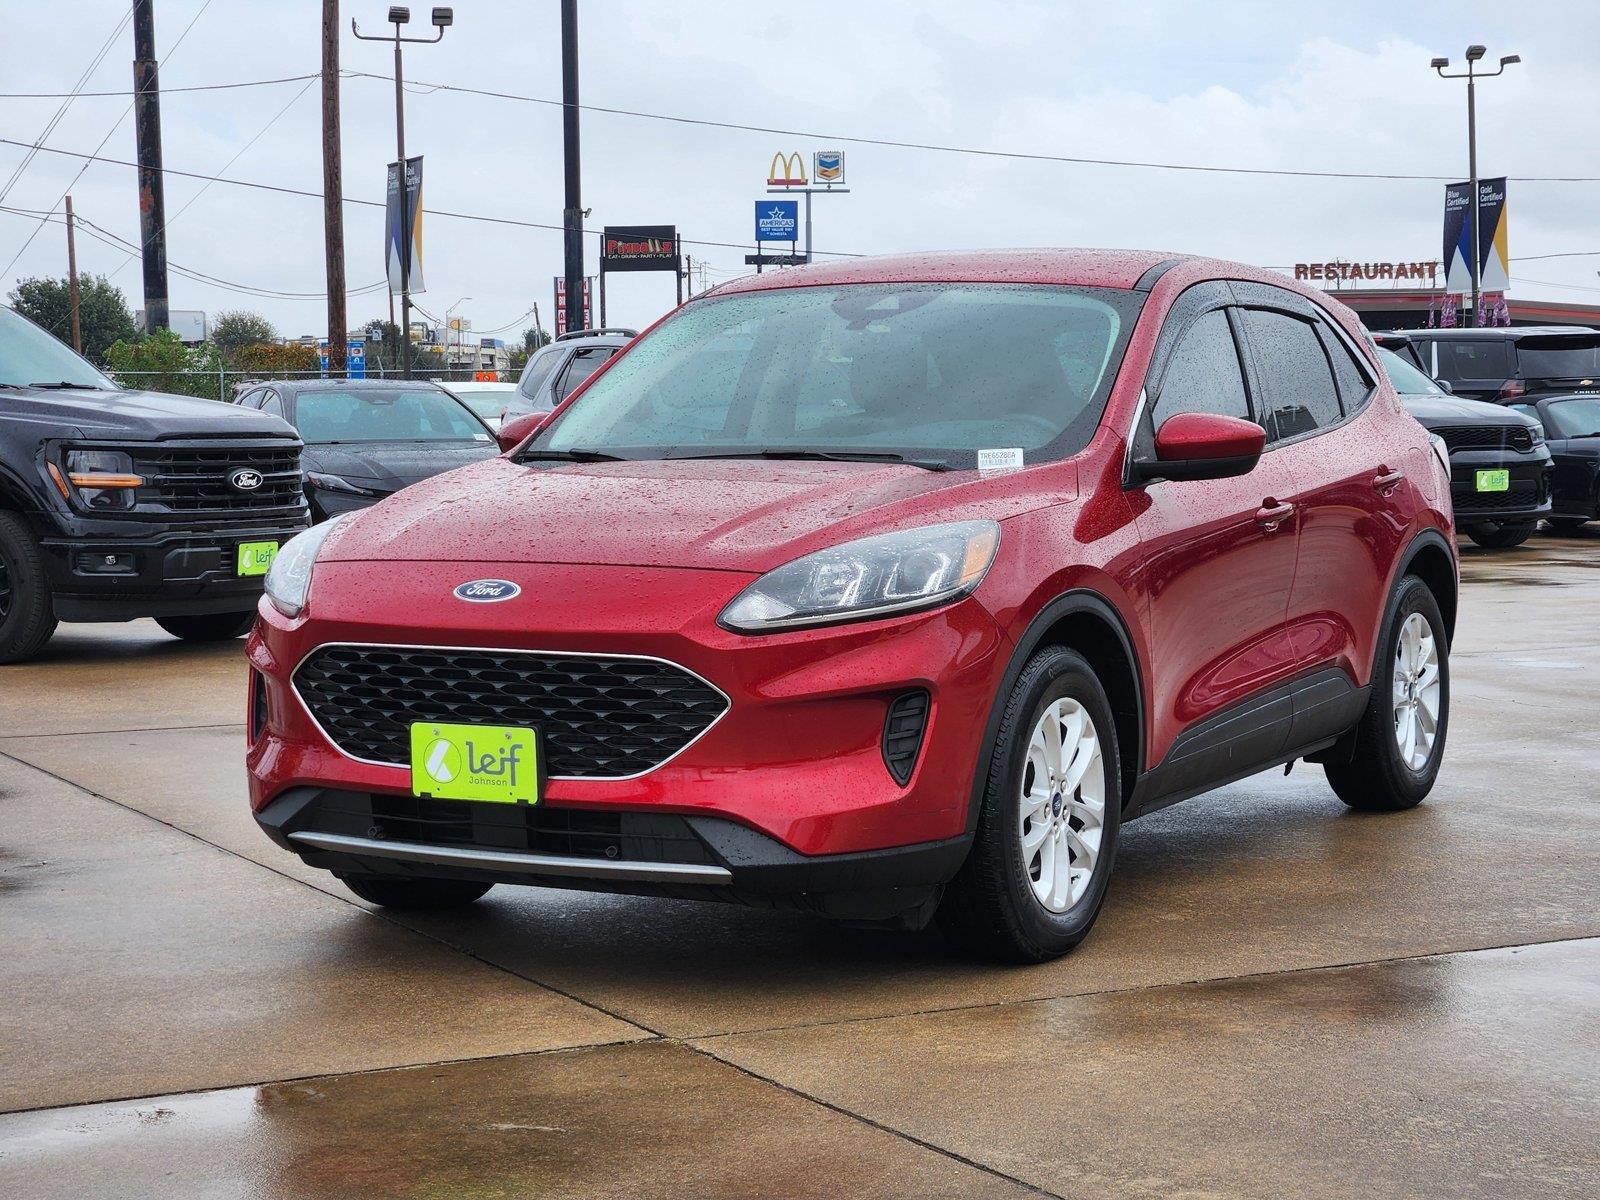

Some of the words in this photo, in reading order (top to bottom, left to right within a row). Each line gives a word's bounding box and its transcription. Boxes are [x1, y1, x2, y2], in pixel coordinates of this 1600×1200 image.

[1447, 190, 1460, 199] Blue
[1480, 185, 1493, 194] Gold
[1446, 197, 1470, 206] Certified
[1480, 192, 1504, 202] Certified
[761, 219, 794, 227] AMERICAS
[1294, 261, 1438, 280] RESTAURANT
[238, 473, 258, 486] Ford
[255, 549, 273, 567] leif
[466, 582, 506, 596] Ford
[465, 740, 524, 787] leif
[468, 776, 508, 787] Johnson
